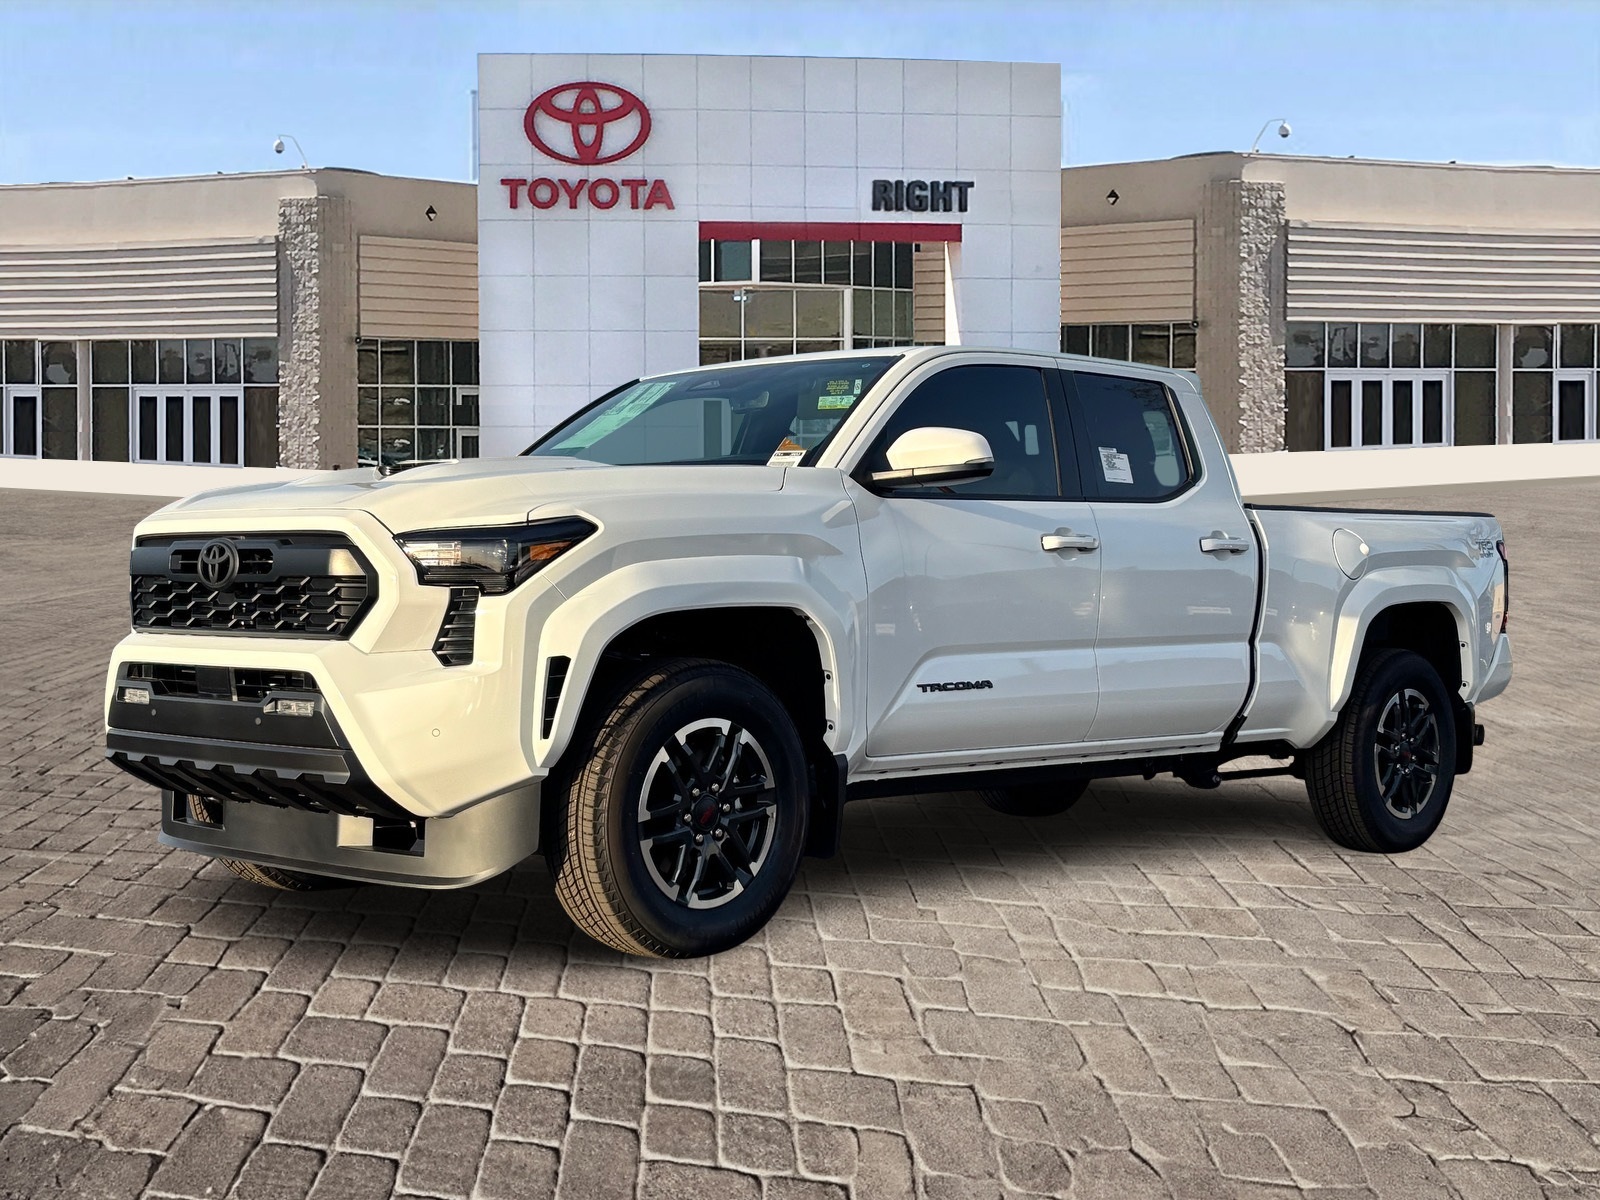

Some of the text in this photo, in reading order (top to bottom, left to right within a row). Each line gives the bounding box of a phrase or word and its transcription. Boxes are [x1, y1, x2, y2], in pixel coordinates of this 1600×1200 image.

[500, 178, 676, 210] TOYOTA
[872, 179, 975, 212] RIGHT
[916, 679, 994, 693] TACOMA
